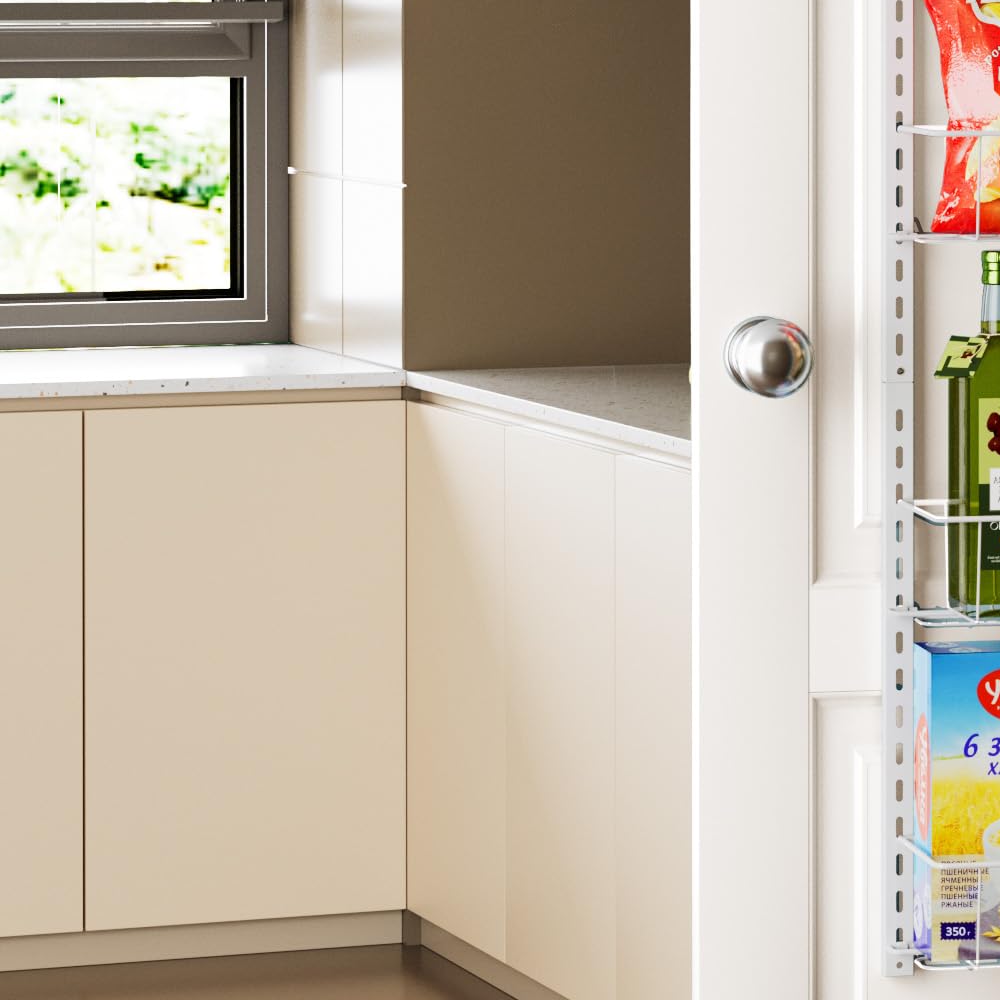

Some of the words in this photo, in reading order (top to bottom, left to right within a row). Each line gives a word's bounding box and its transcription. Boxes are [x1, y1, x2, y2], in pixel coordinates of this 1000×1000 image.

[963, 733, 979, 758] 6
[941, 876, 984, 884] ЯЧМЕННЫ
[945, 926, 966, 937] 350
